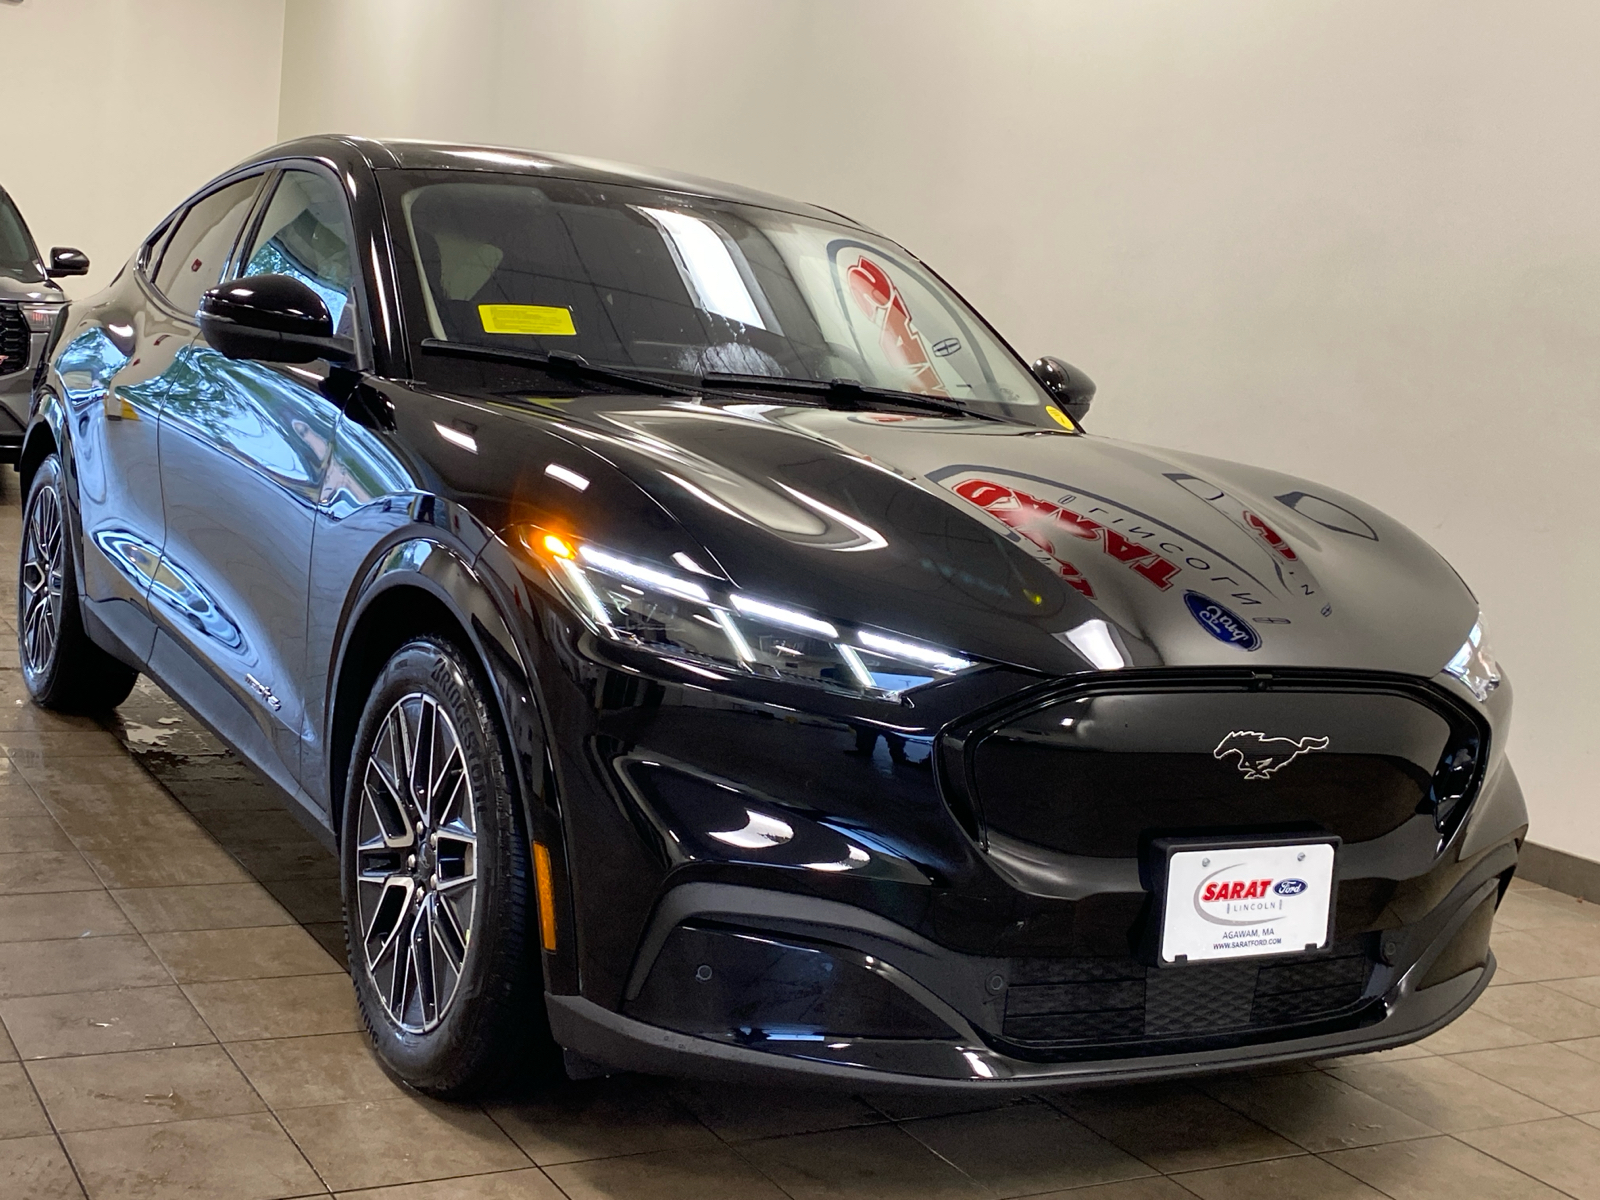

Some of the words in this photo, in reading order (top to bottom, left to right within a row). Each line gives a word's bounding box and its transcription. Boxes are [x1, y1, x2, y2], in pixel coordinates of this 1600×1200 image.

[431, 657, 487, 817] BRIDGESTONE
[1202, 879, 1273, 902] SARAT
[1234, 902, 1276, 911] LINCOLN
[1223, 929, 1260, 940] AGAWAM,
[1263, 928, 1275, 936] MA
[1213, 938, 1282, 949] WWW.SARATFORD.COM
